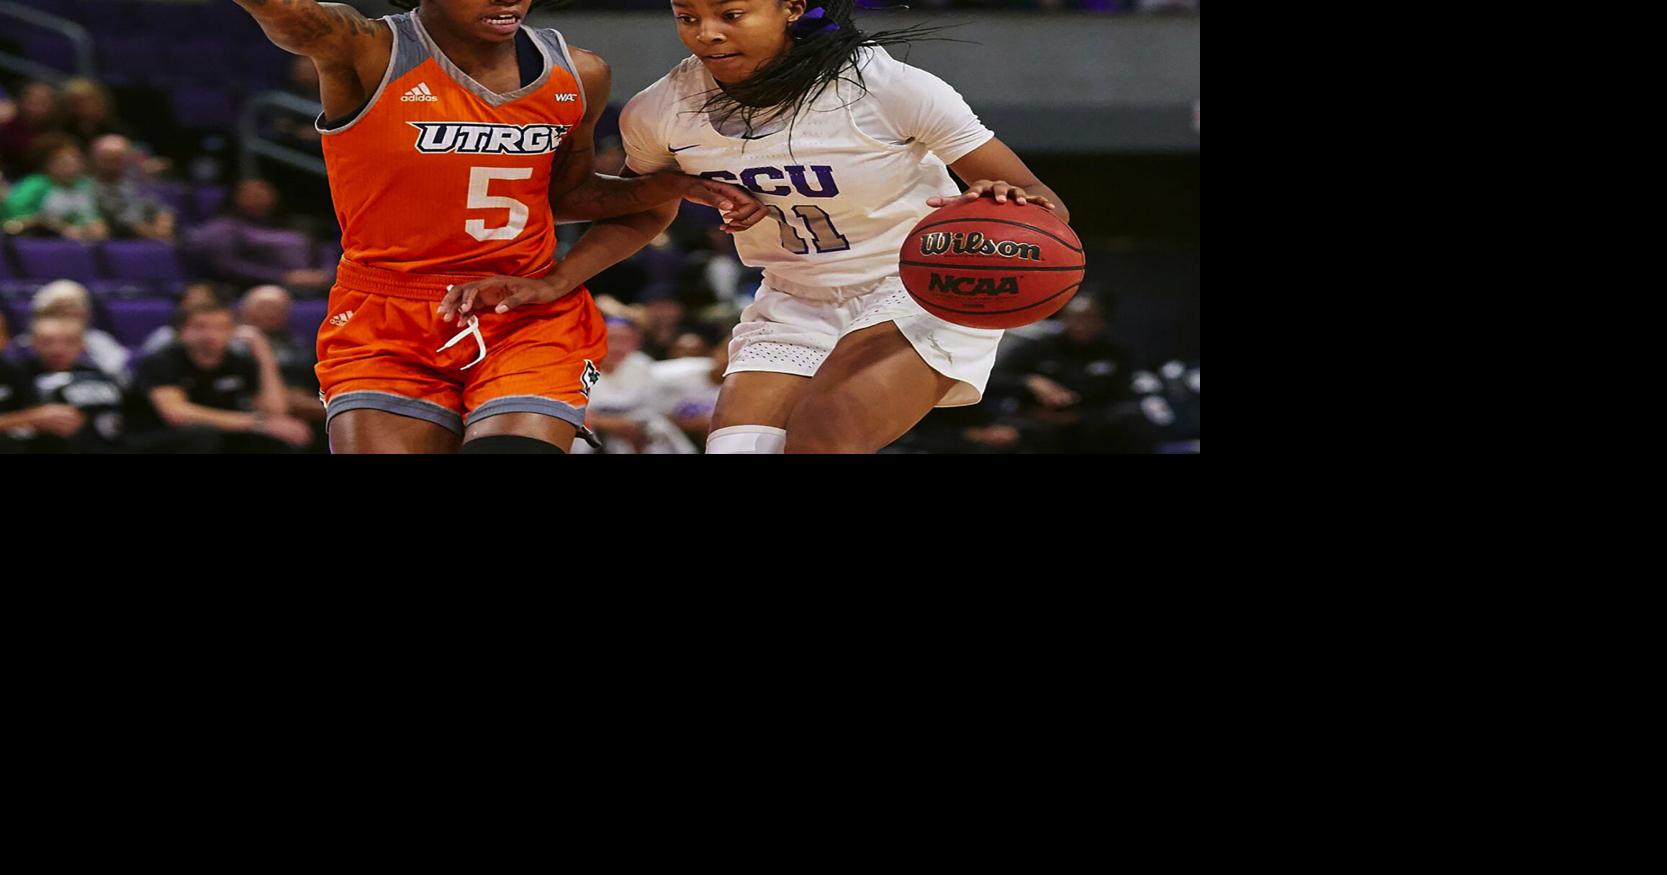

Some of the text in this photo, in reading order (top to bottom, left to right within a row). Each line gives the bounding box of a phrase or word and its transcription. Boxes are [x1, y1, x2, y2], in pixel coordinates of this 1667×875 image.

[400, 94, 438, 102] adidas
[465, 166, 534, 242] 5
[765, 204, 850, 254] 11
[920, 231, 1041, 262] Wilson
[928, 272, 1019, 296] NCAA
